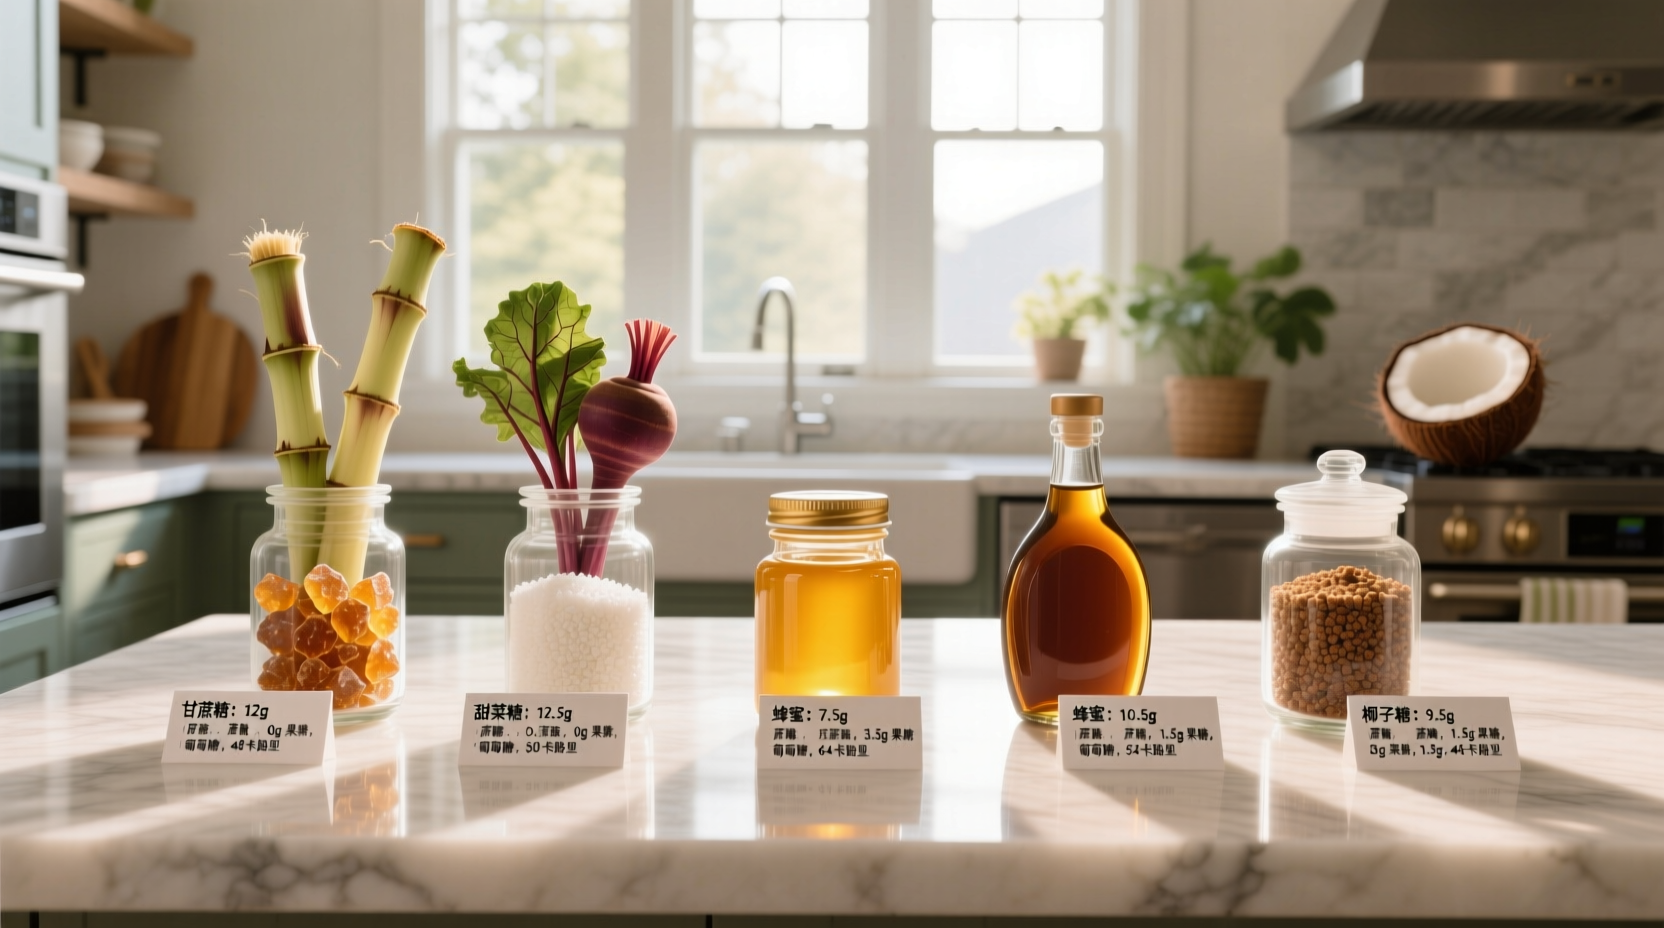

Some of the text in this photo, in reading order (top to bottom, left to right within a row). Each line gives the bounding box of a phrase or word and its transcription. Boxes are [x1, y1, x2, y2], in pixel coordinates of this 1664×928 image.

[245, 704, 269, 720] 12g
[537, 706, 573, 722] 12.5g
[818, 708, 848, 725] 7.5g
[1120, 708, 1157, 725] 10.5g
[1425, 708, 1455, 724] 9.5g
[267, 724, 282, 738] 0g
[574, 726, 588, 740] 0g
[864, 728, 888, 743] 3.5g
[1160, 728, 1184, 743] 1.5g
[1451, 727, 1475, 741] 1.5g
